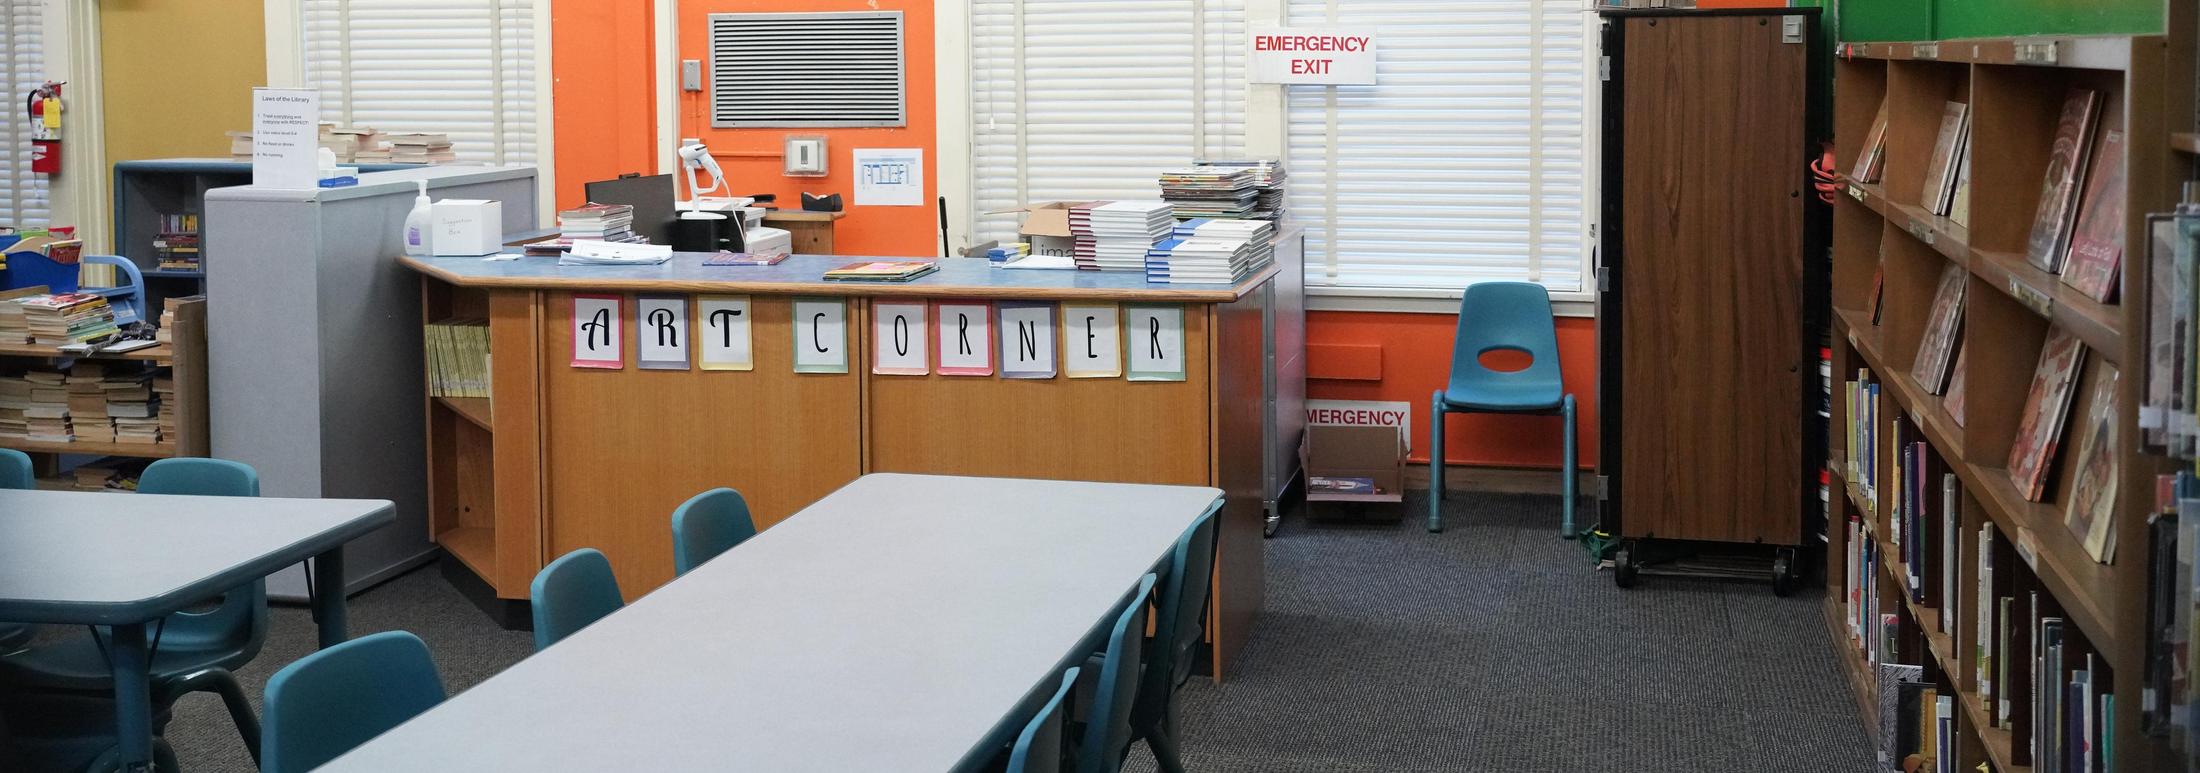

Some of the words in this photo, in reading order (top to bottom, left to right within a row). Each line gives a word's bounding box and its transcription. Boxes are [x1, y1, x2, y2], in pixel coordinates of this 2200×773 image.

[1255, 36, 1369, 52] EMERGENCY
[1291, 59, 1333, 74] EXIT
[1306, 409, 1405, 426] MERGENCY
